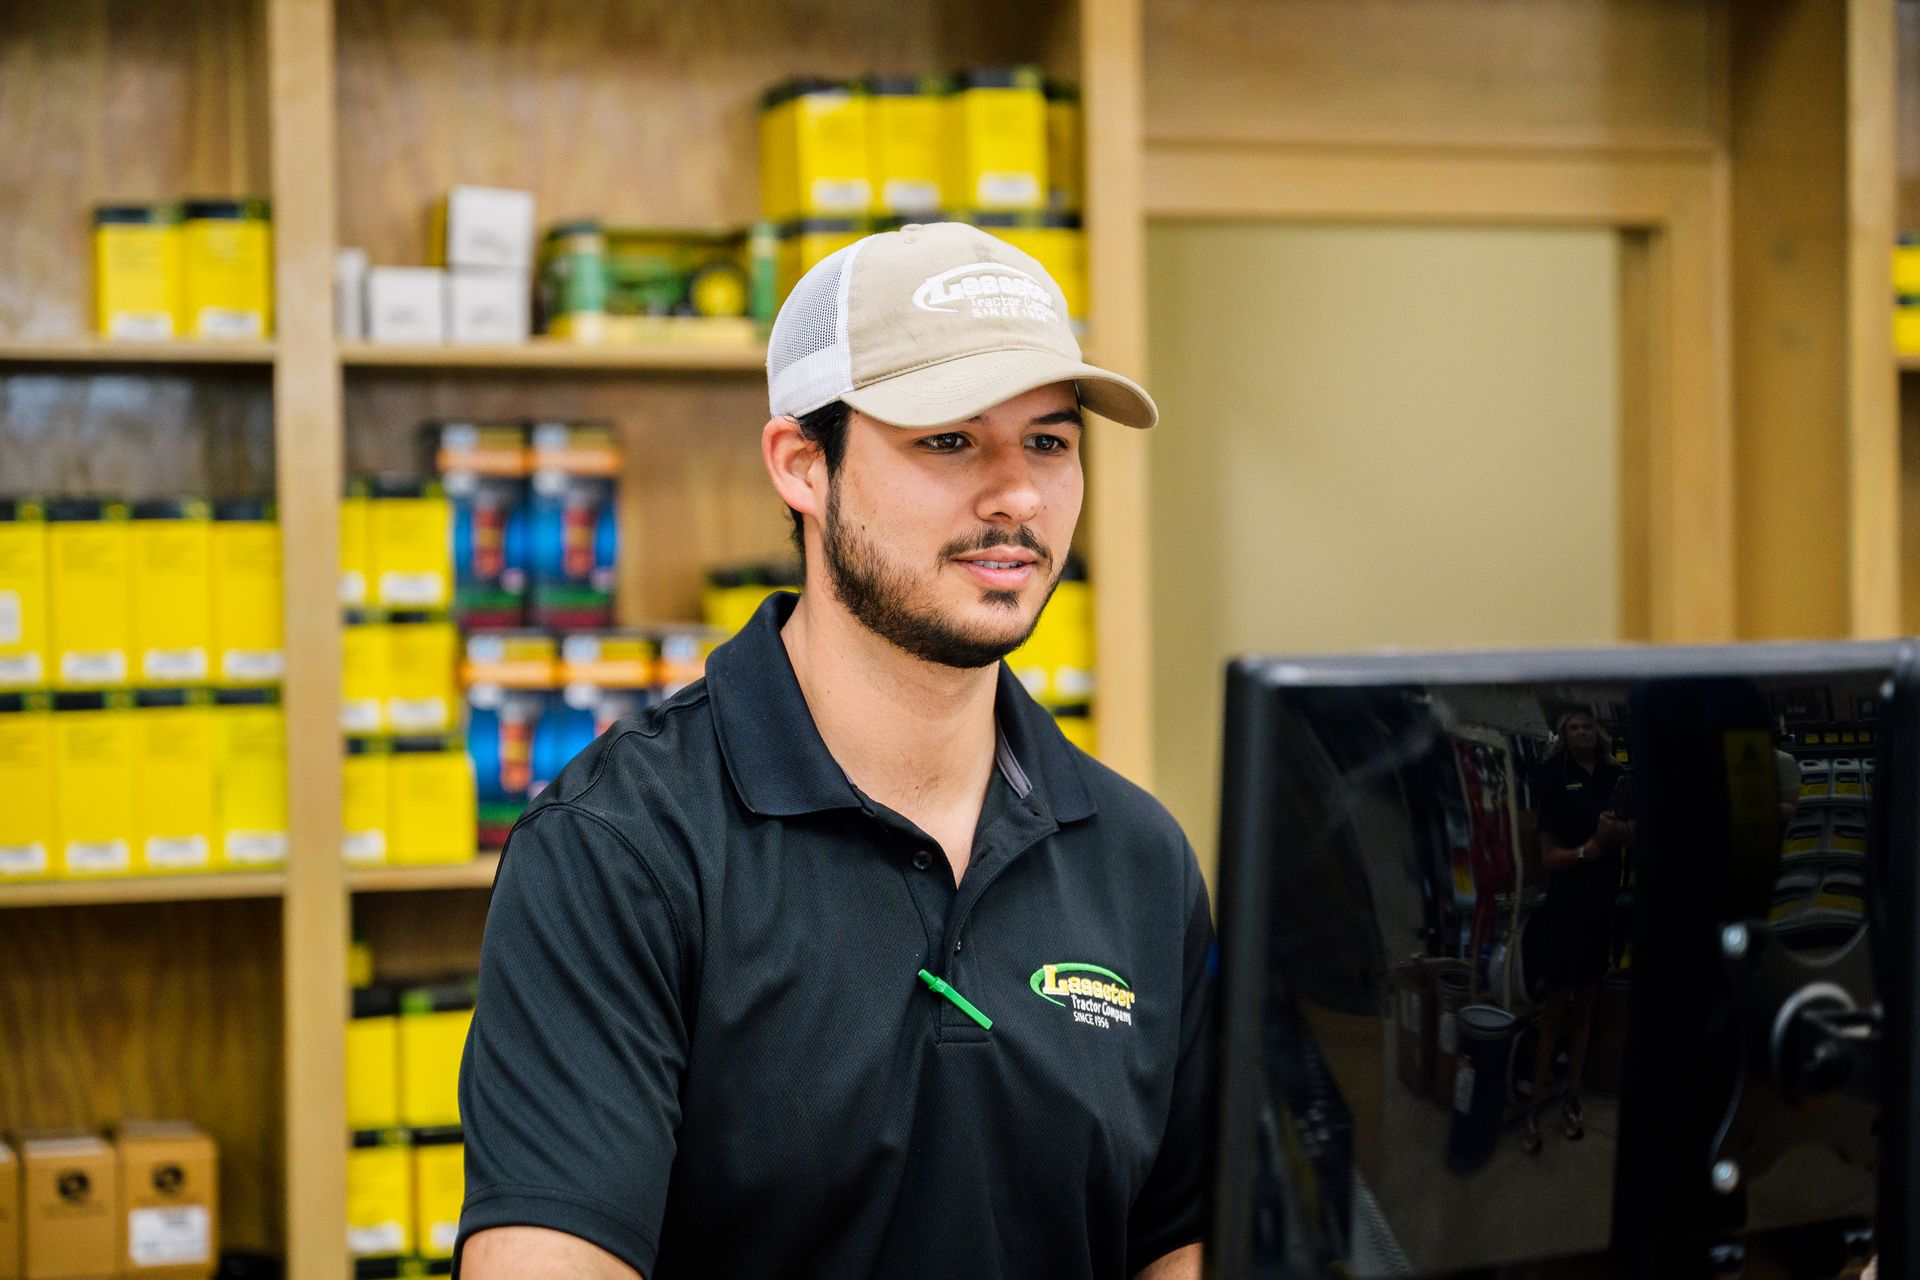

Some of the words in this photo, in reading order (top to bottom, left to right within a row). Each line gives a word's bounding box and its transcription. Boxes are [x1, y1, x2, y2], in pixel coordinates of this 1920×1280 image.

[970, 295, 1022, 308] Tractor
[1071, 995, 1101, 1014] Tractor
[1102, 1002, 1132, 1026] Company
[1073, 1011, 1095, 1026] SINCE
